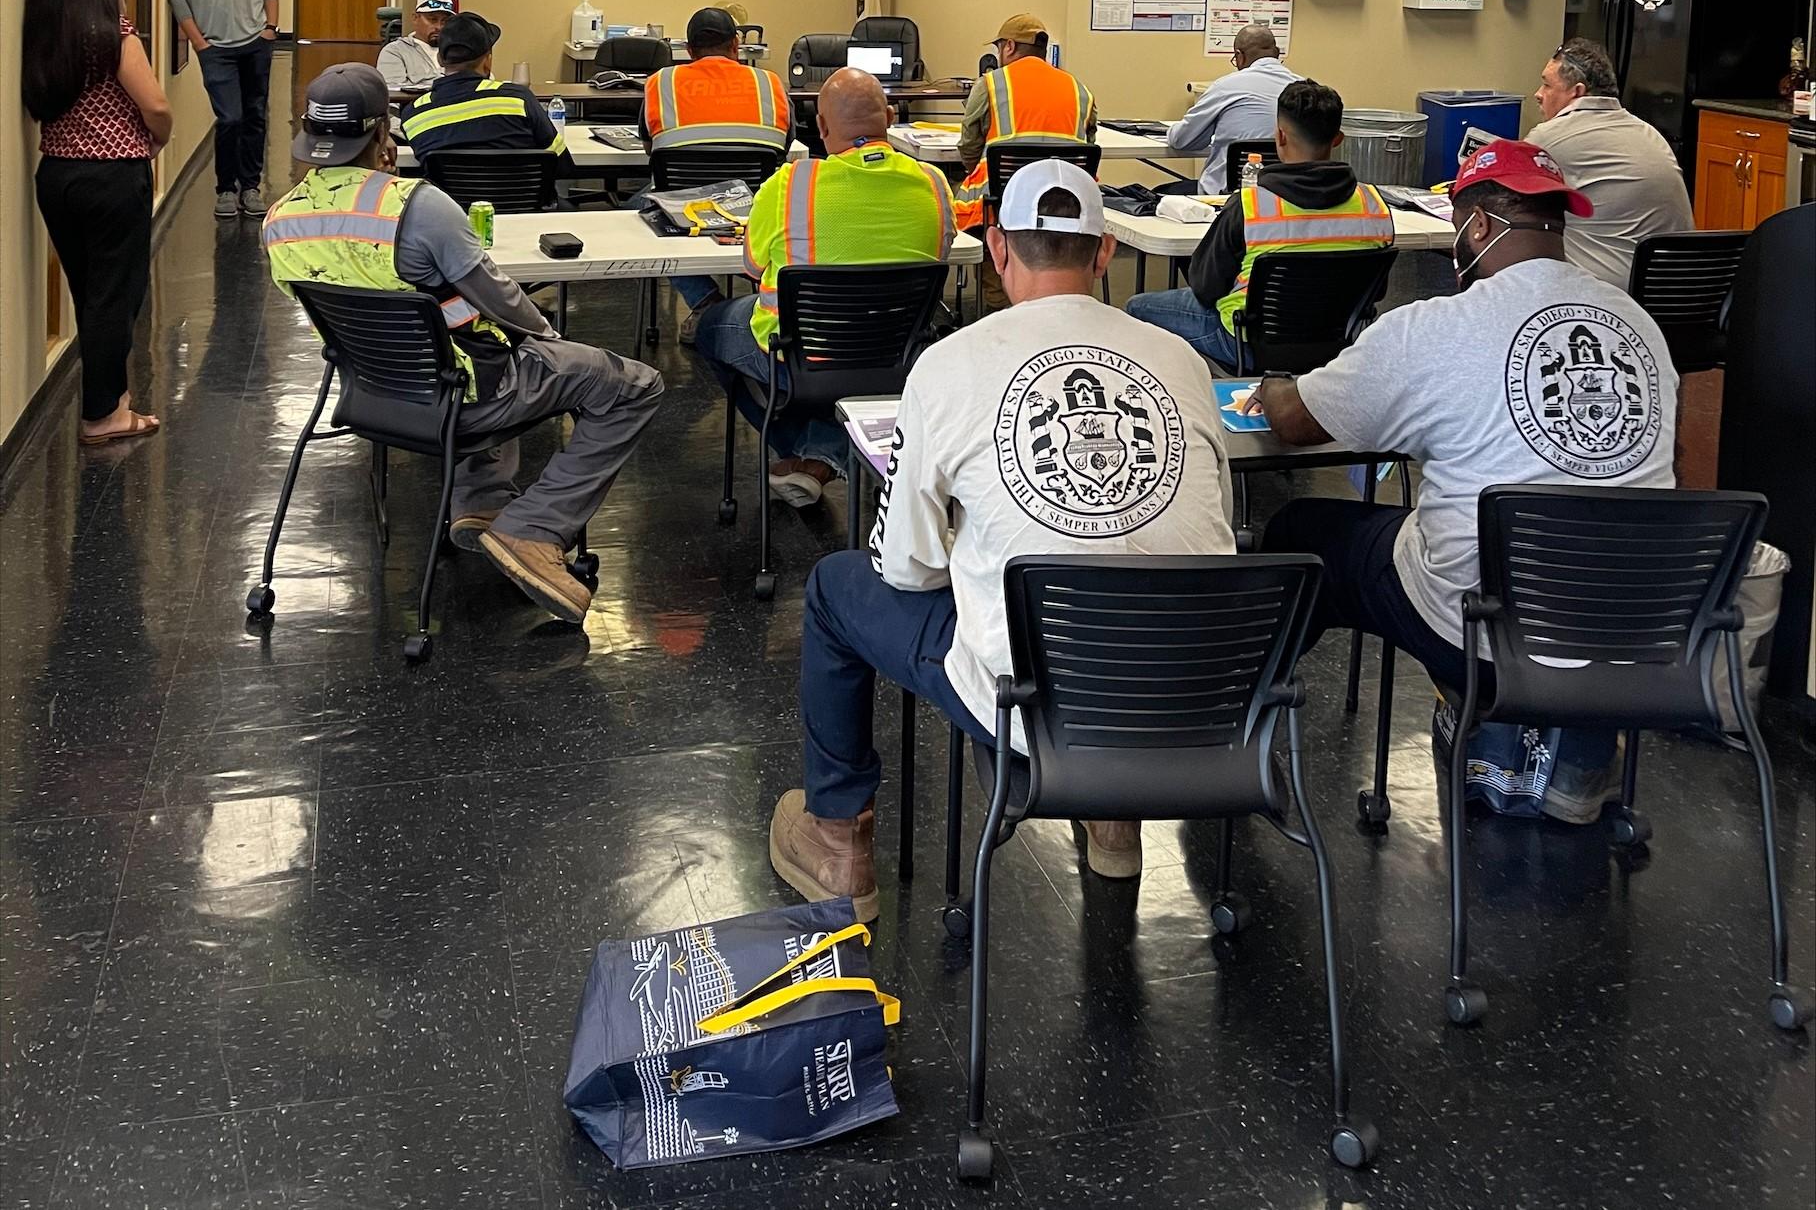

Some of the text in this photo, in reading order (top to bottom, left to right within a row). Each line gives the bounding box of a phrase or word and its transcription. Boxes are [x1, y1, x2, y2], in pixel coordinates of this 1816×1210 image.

[661, 259, 679, 274] 127
[1537, 308, 1576, 327] DIEGO
[1584, 308, 1624, 333] STATE
[1518, 326, 1540, 350] SAN
[1629, 332, 1644, 350] OF
[1511, 351, 1524, 371] OF
[1510, 377, 1526, 412] CITY
[998, 349, 1183, 508] THE CITY OF SAN DIEGO STATE OF CALIFORNIA
[1519, 414, 1541, 445] THE
[1550, 449, 1643, 473] SEMPER VIGILANS
[1047, 500, 1158, 532] SEMPER VIGILANS
[826, 1040, 851, 1103] SHARP
[817, 1082, 831, 1111] PLAN
